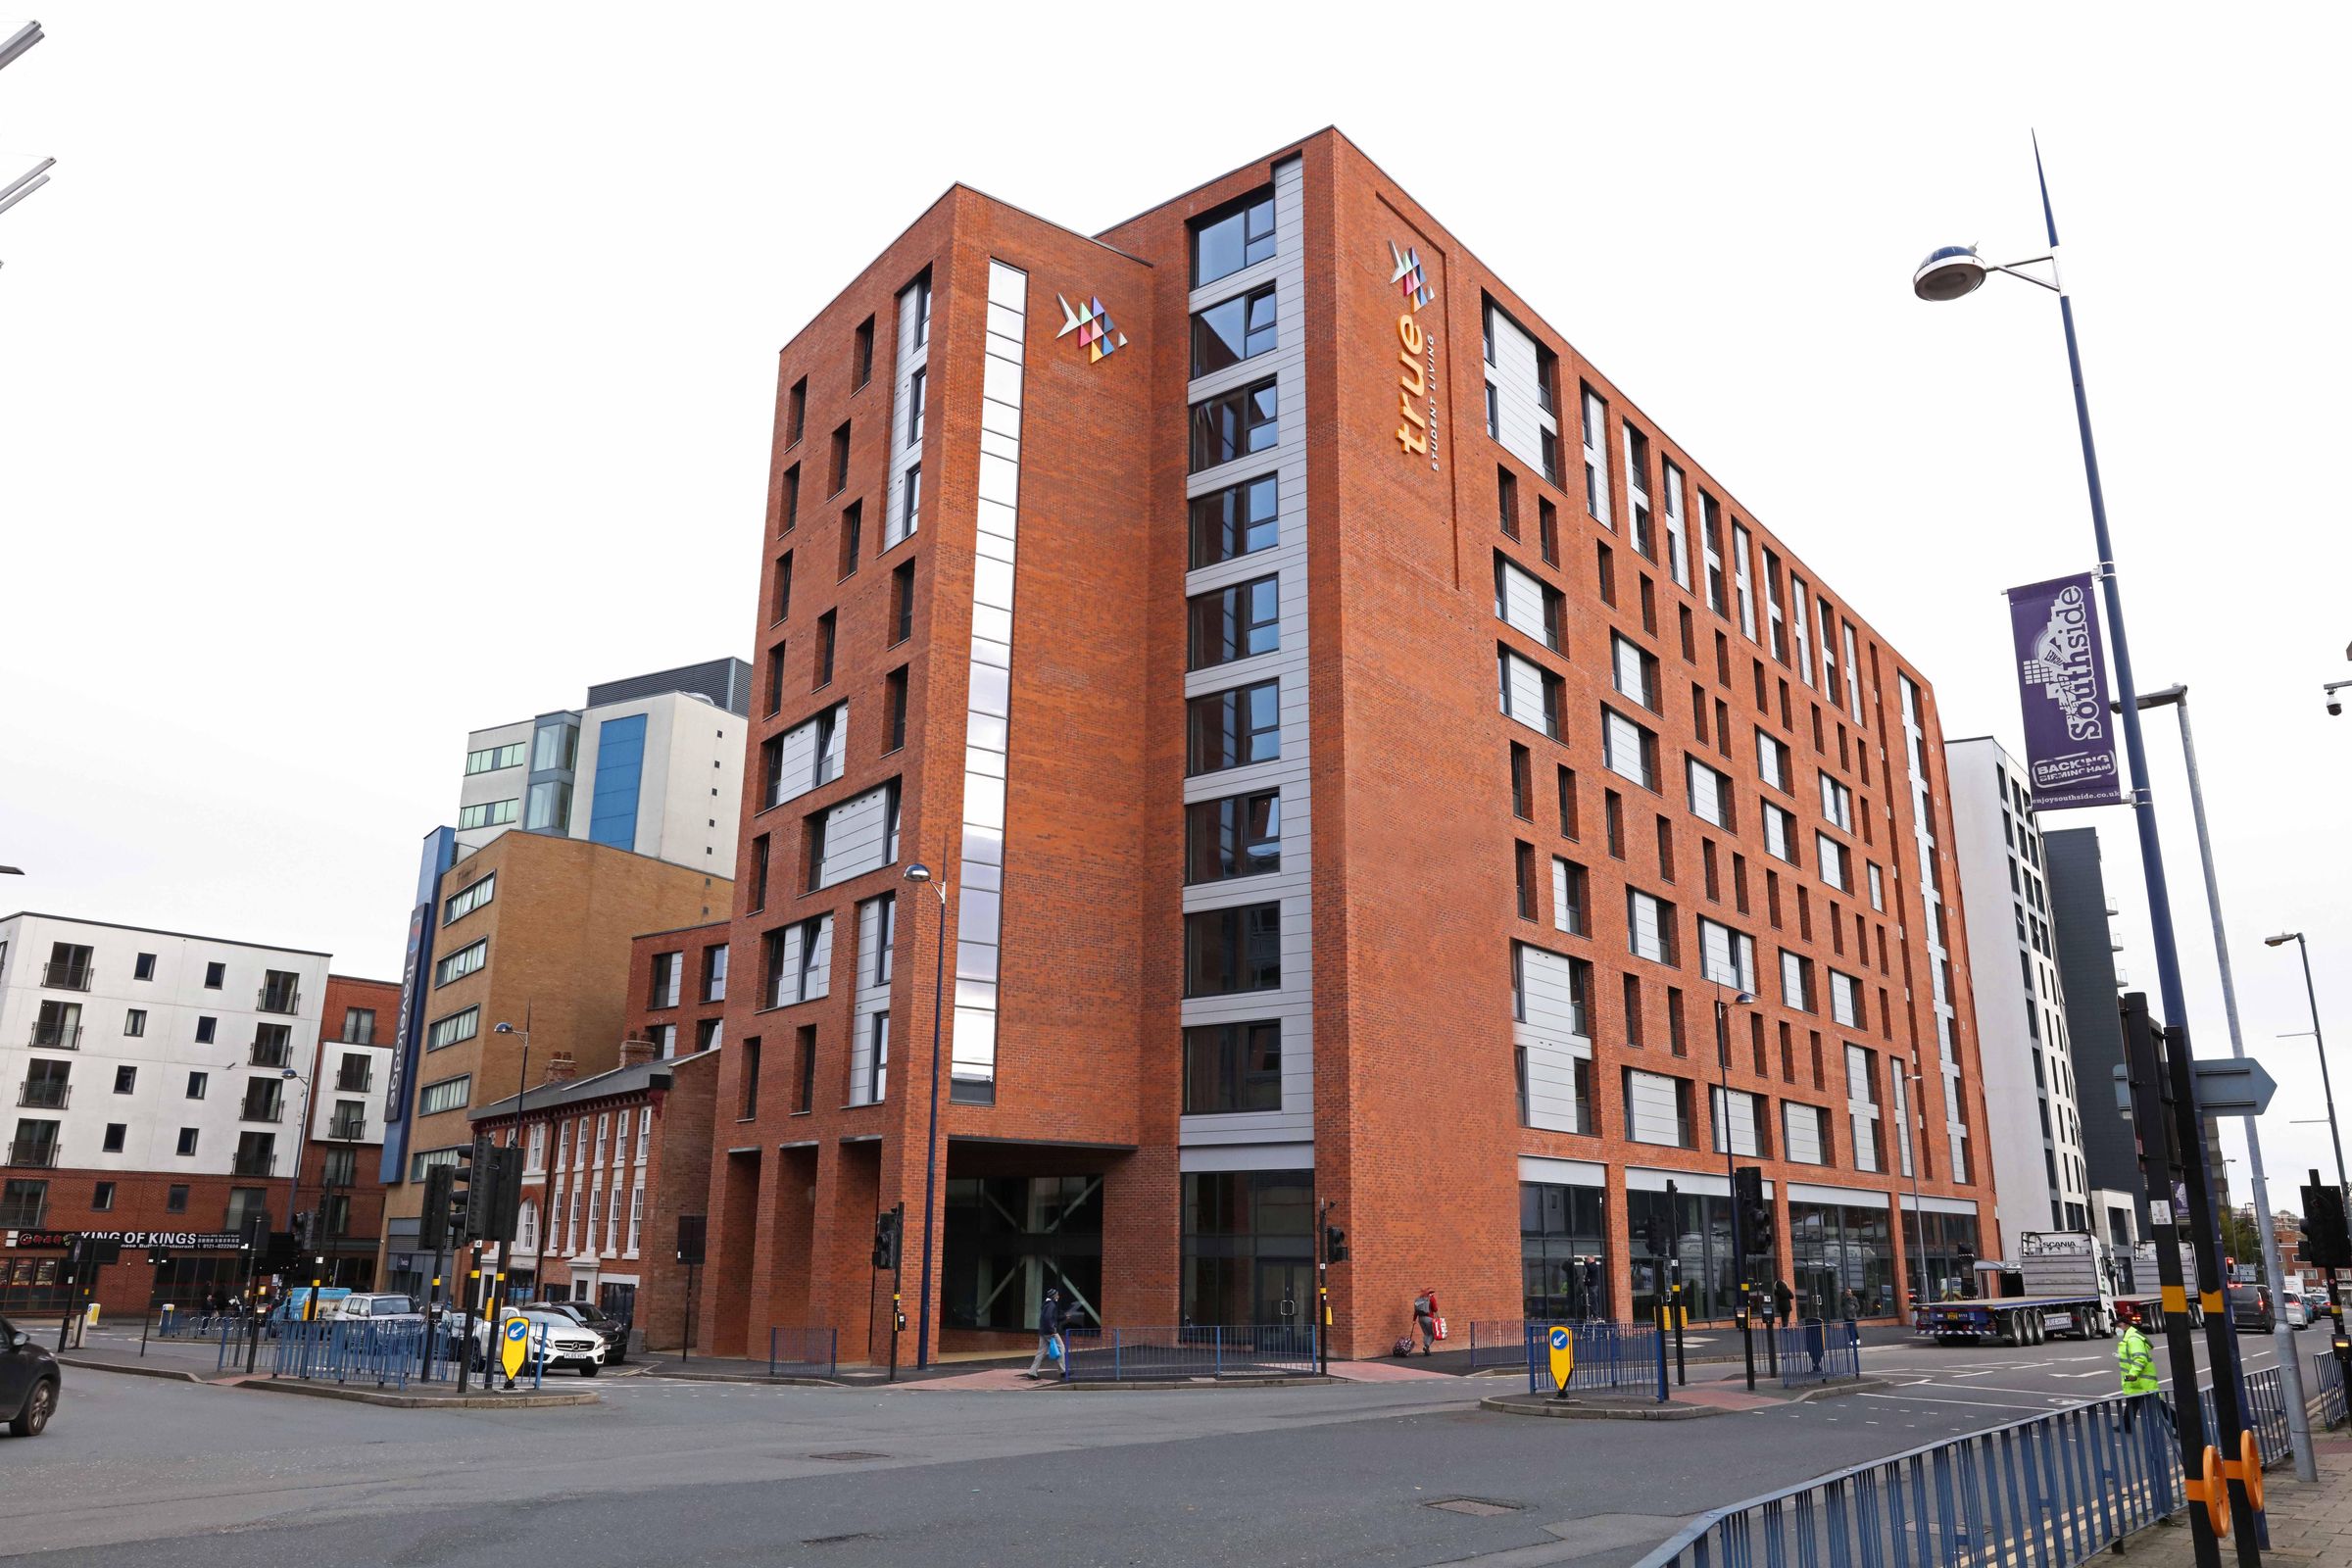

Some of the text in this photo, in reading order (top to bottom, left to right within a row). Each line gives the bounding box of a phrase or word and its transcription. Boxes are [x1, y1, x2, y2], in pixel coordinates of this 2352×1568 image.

[1396, 315, 1427, 454] true
[1427, 333, 1439, 472] STUDENT LIVING
[2056, 587, 2101, 739] southside
[2032, 791, 2121, 805] enjoysouthside.co.uk
[2037, 755, 2110, 775] BACKING
[2039, 763, 2112, 782] BIRMINGHAM
[390, 956, 416, 1108] Travelodge
[124, 1232, 146, 1244] OF
[148, 1233, 196, 1245] KINGS
